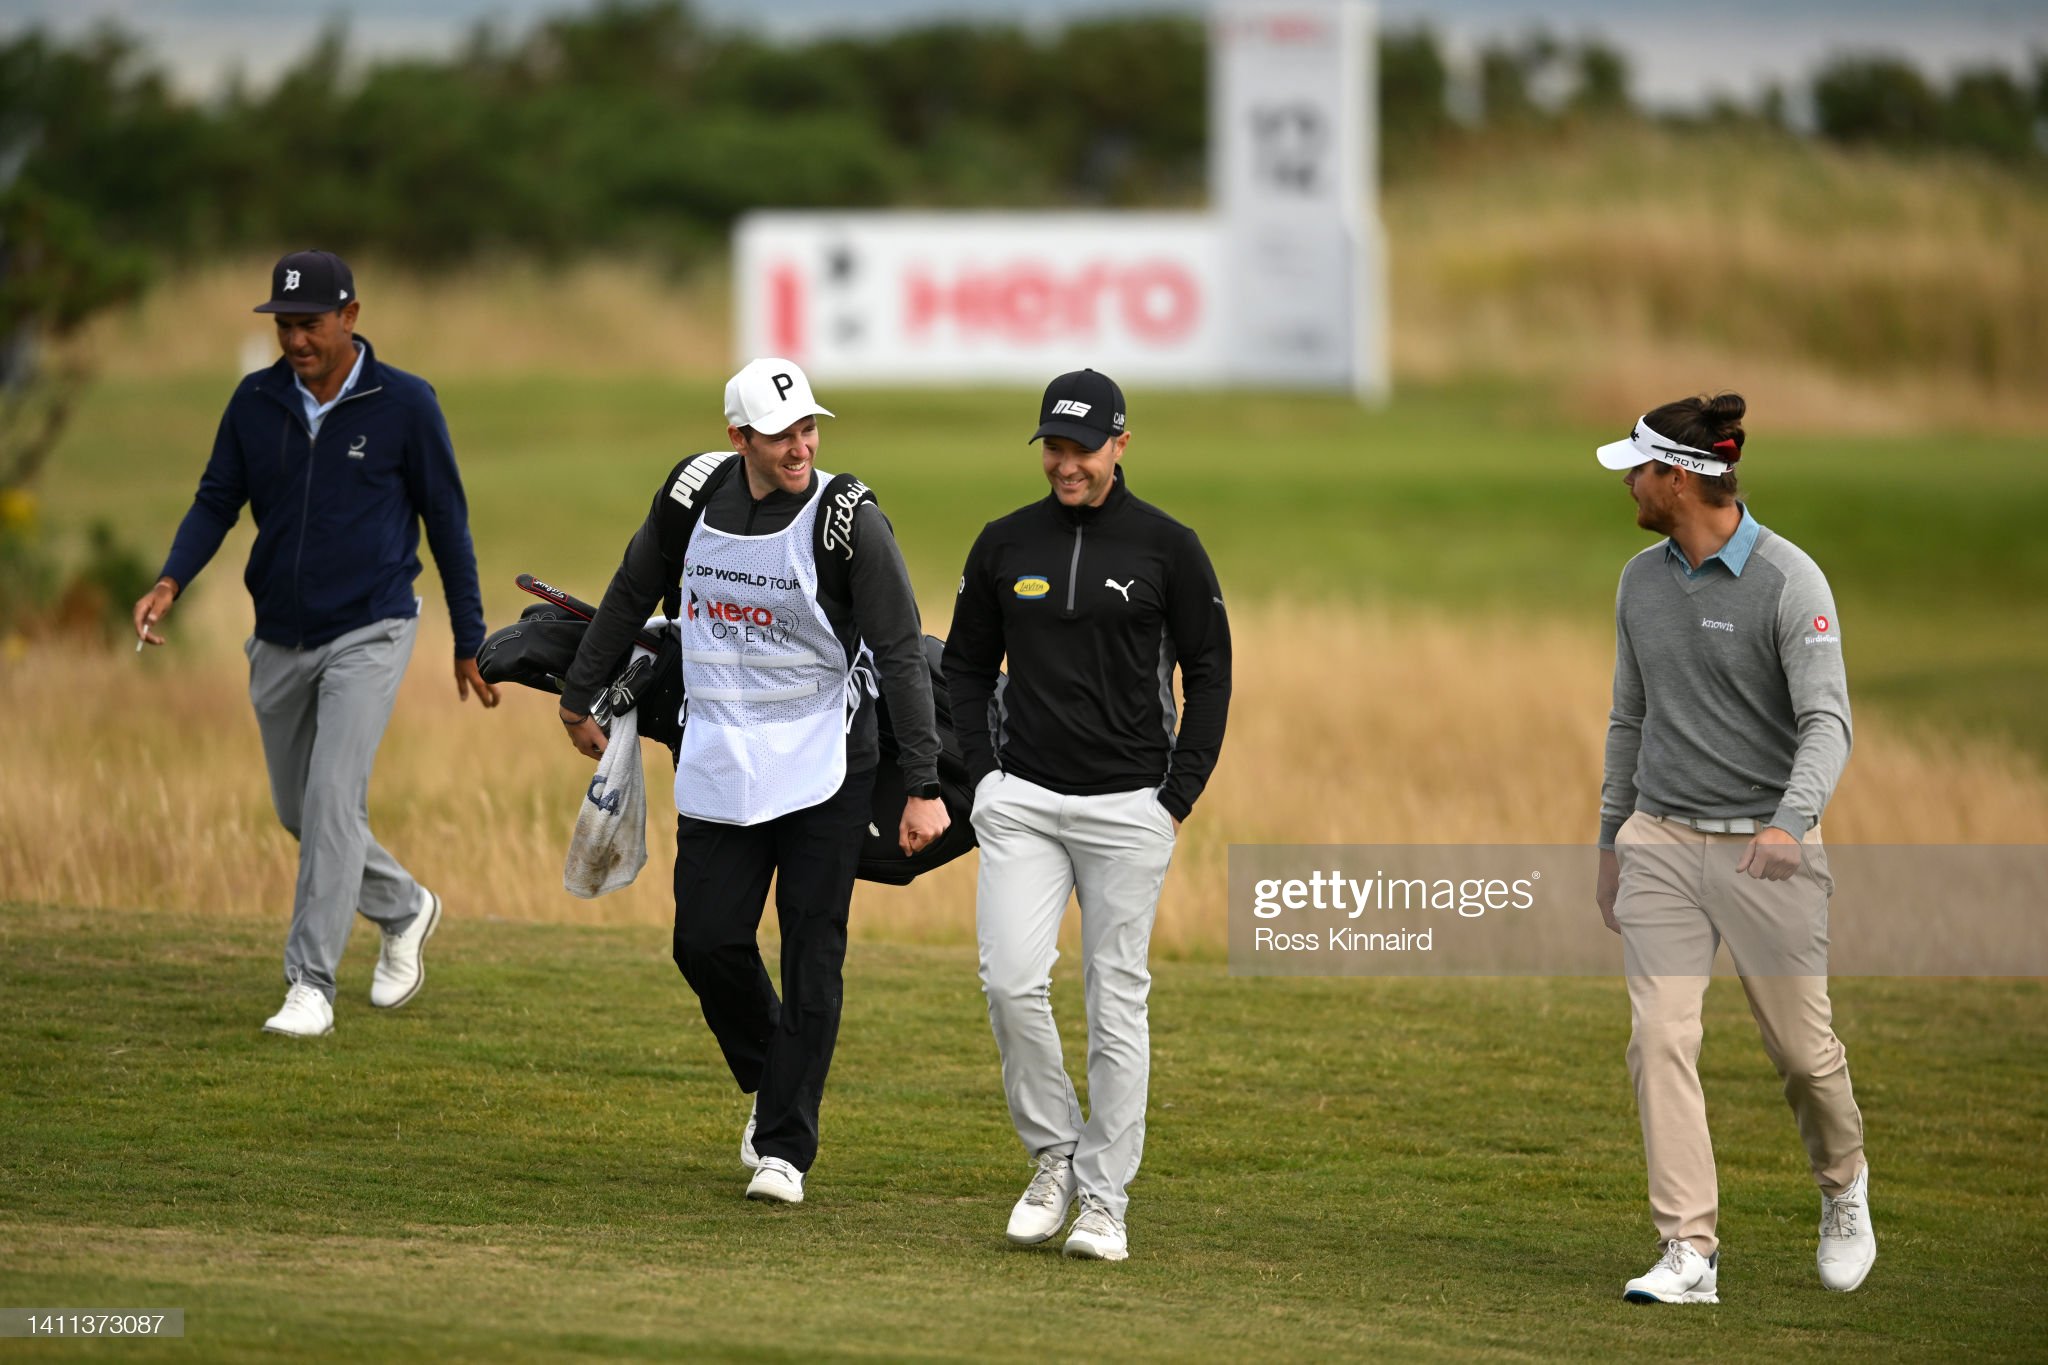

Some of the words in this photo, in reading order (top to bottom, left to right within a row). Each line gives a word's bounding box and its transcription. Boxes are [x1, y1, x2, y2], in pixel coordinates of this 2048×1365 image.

[772, 373, 794, 402] P
[1052, 400, 1092, 418] MS
[1664, 452, 1690, 467] PRO
[696, 565, 714, 577] DP
[715, 569, 767, 587] WORLD
[769, 577, 801, 591] TOUR
[706, 600, 773, 626] Hero
[1701, 618, 1735, 632] knowit
